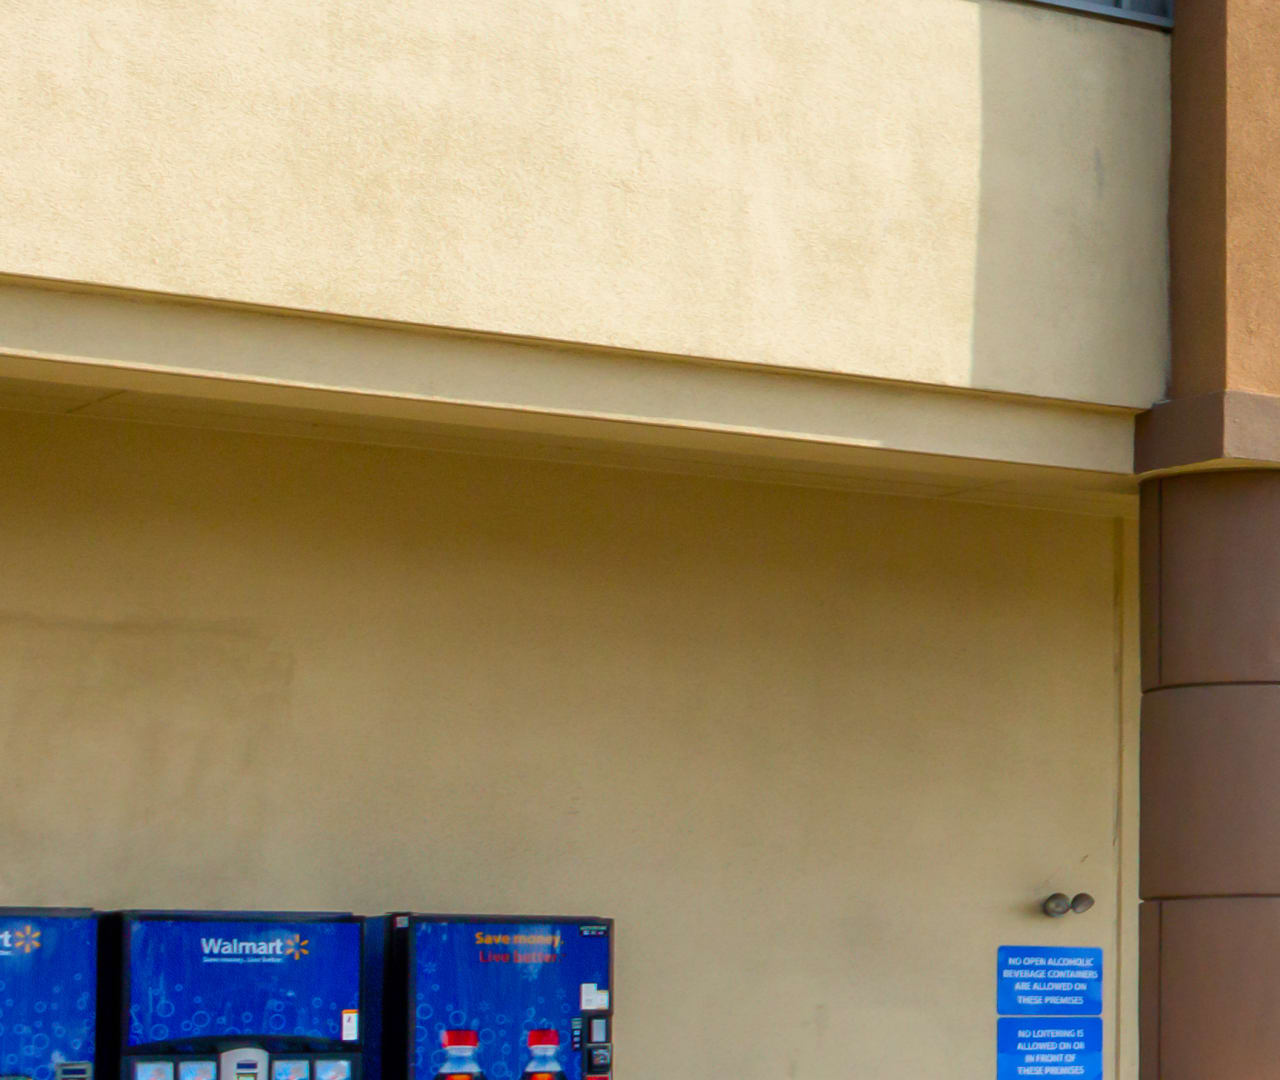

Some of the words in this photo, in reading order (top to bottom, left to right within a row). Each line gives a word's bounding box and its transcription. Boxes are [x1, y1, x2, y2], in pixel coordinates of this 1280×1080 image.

[475, 931, 510, 944] Save
[200, 937, 283, 954] Walmart
[480, 950, 510, 963] Live
[1008, 957, 1022, 966] NO
[1023, 957, 1046, 966] OPEN
[1047, 958, 1094, 967] ALCOHOLIC
[1003, 969, 1046, 978] BEVERAGE
[1047, 970, 1098, 979] CONTAINERS
[1014, 982, 1031, 990] ARE
[1032, 982, 1073, 991] ALLOWED
[1074, 982, 1087, 991] ON
[1017, 996, 1043, 1004] THESE
[1044, 996, 1084, 1005] PREMISES
[1017, 1029, 1031, 1038] NO
[1032, 1029, 1075, 1038] LOITERING
[1077, 1029, 1084, 1038] IS
[1017, 1041, 1058, 1050] ALLOWED
[1059, 1042, 1072, 1050] ON
[1036, 1053, 1063, 1062] FRONT
